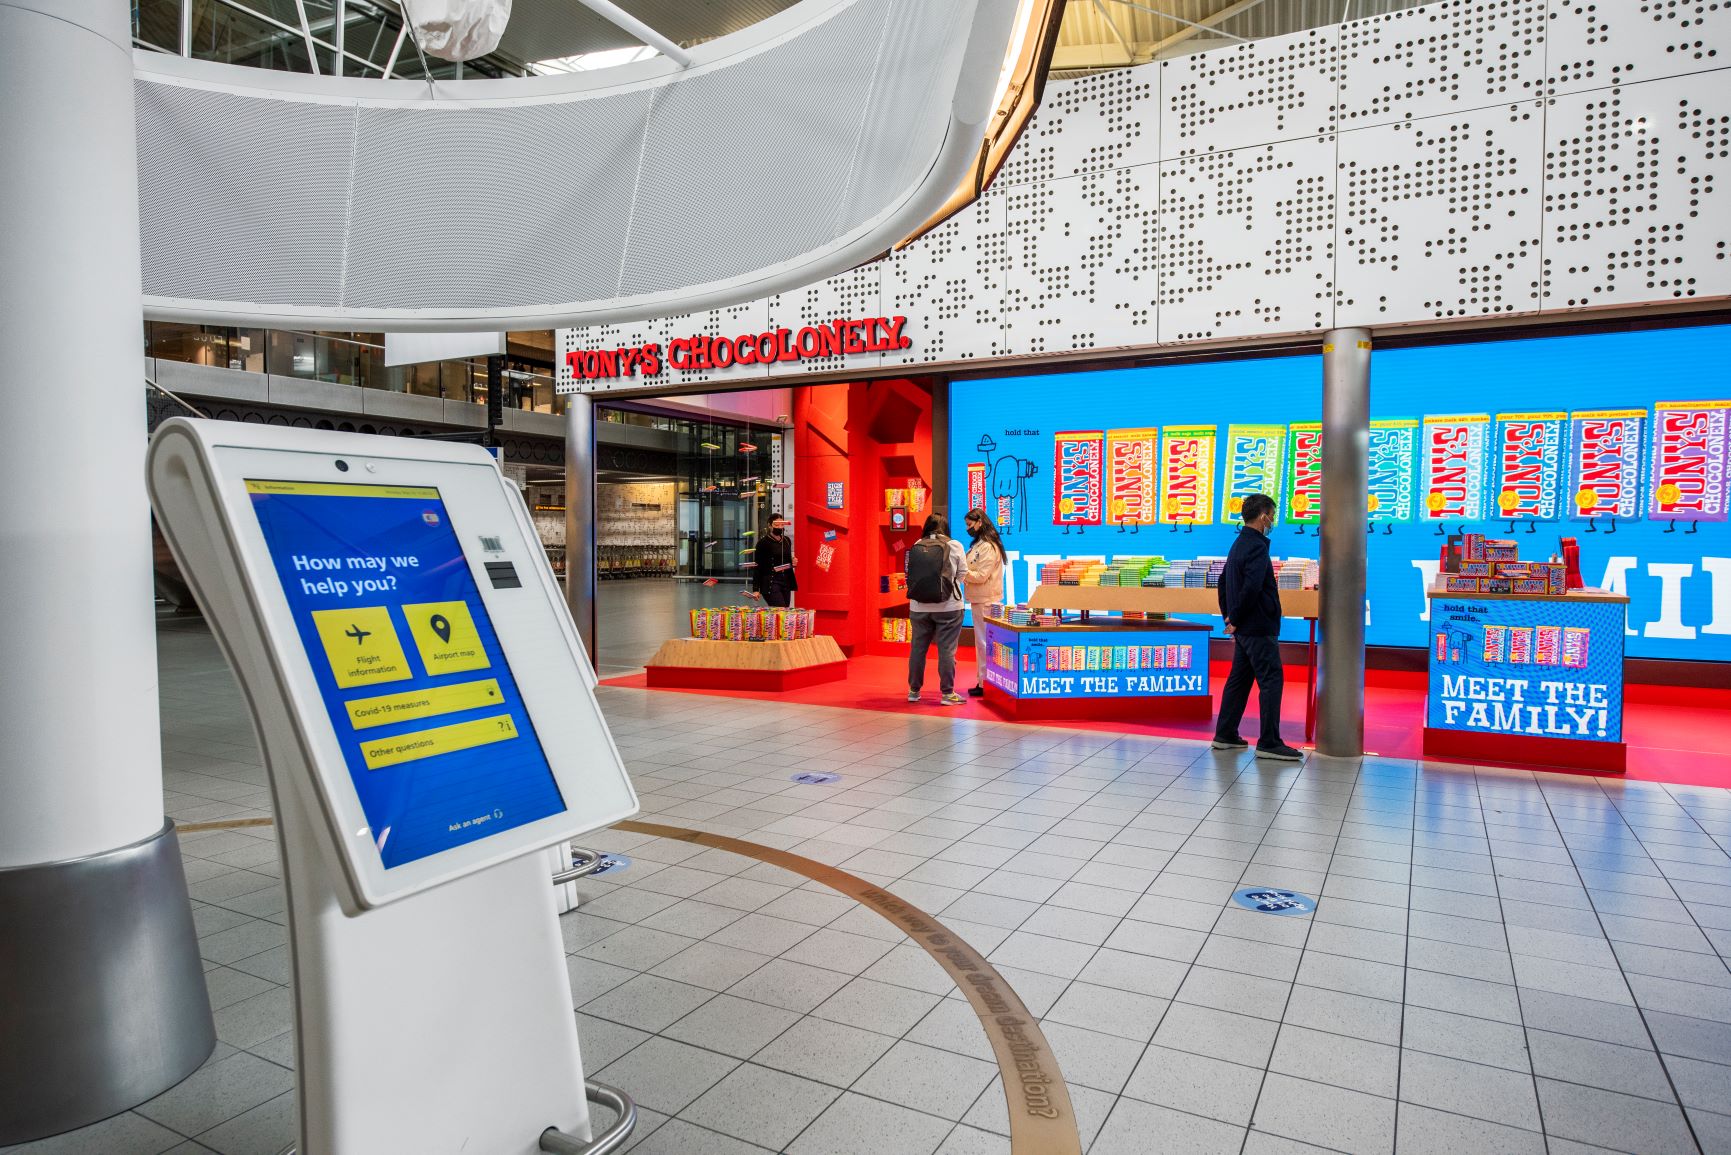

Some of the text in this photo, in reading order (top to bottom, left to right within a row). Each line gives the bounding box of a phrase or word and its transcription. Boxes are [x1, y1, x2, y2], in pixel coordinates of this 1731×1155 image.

[566, 316, 912, 379] TONY'S CHOCOLONELY.
[1499, 422, 1545, 518] TONY'S
[1576, 420, 1624, 518] TONY'S
[1657, 411, 1709, 513] TONY'S
[292, 555, 419, 572] How may we
[300, 575, 397, 597] help you?
[1444, 604, 1489, 614] hold that
[356, 654, 381, 665] Flight
[433, 650, 476, 662] Airport map
[348, 665, 397, 677] information
[1022, 675, 1203, 694] MEET THE FAMILY!
[1441, 674, 1608, 708] MEET THE
[355, 700, 430, 718] Covid-19 measures
[1441, 700, 1608, 737] FAMILY!
[369, 739, 434, 758] Other questions
[448, 814, 491, 831] Ask an agent
[900, 913, 936, 933] way
[926, 933, 950, 946] to
[934, 945, 979, 971] your
[965, 973, 1009, 1013] dream
[996, 1015, 1060, 1119] destination?
